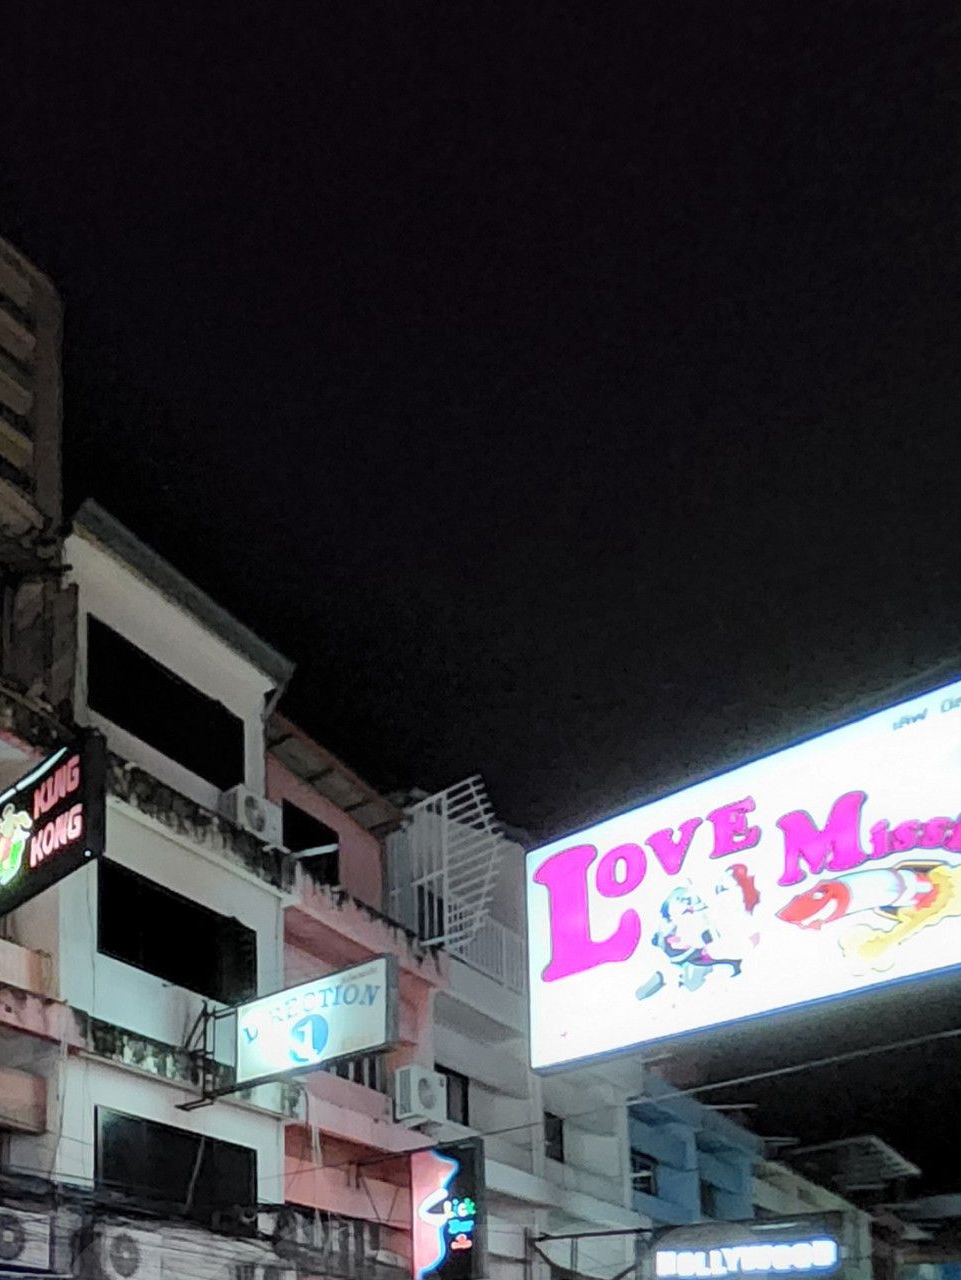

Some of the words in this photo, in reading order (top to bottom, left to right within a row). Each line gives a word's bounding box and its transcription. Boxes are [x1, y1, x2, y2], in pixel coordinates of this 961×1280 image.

[32, 754, 81, 821] KING
[29, 803, 84, 868] KONG
[532, 796, 763, 983] LOVE
[243, 983, 381, 1044] DRECTION
